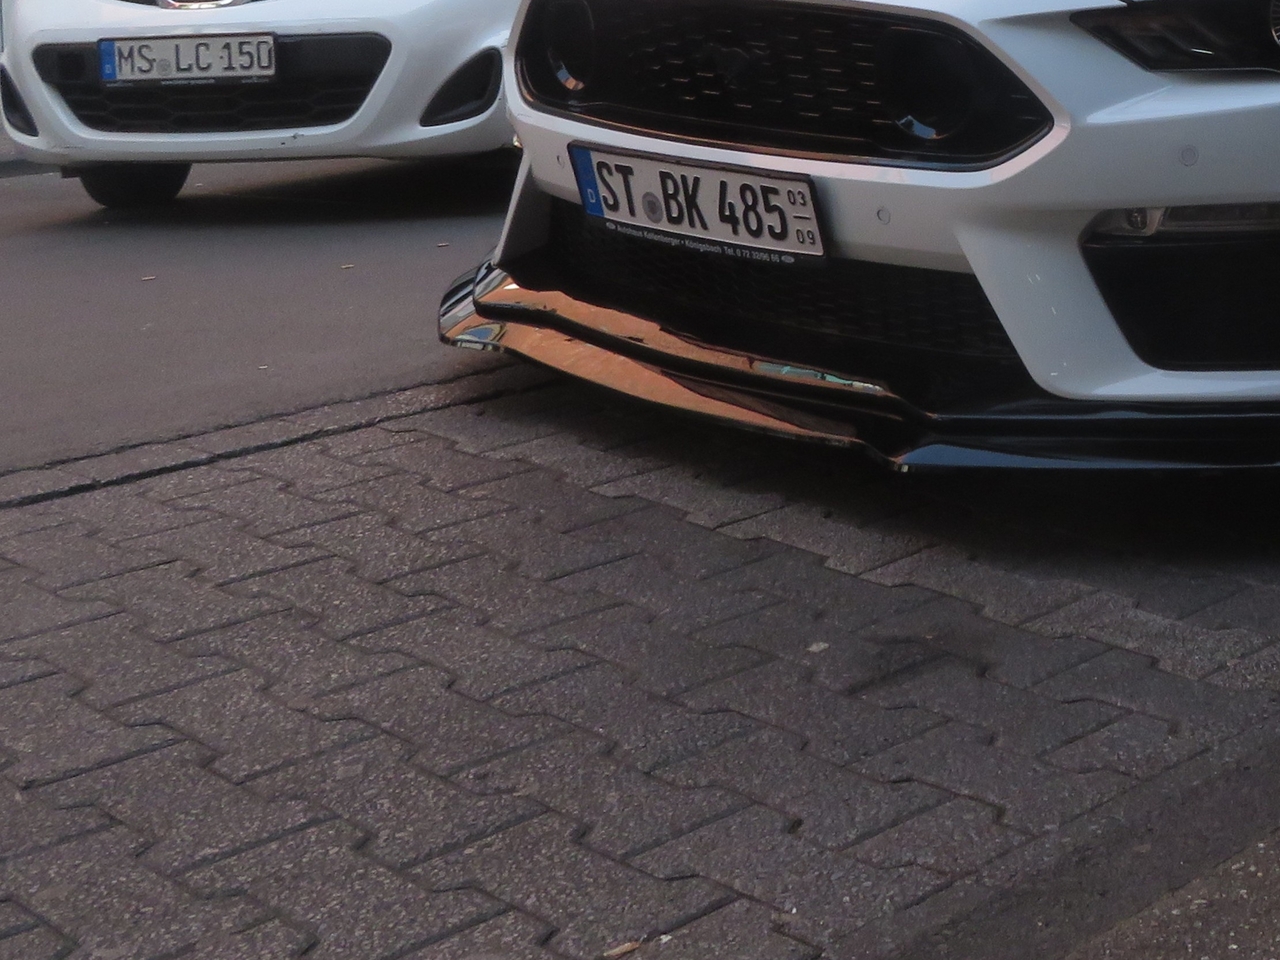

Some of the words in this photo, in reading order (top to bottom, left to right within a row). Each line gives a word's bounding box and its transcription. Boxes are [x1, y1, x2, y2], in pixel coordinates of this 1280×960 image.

[117, 44, 153, 74] MS
[175, 42, 212, 72] LC
[222, 41, 273, 71] 150
[588, 189, 596, 203] D
[596, 160, 636, 218] ST
[659, 170, 708, 231] BK
[718, 179, 788, 241] 485
[787, 189, 807, 207] 03
[797, 228, 816, 246] 09
